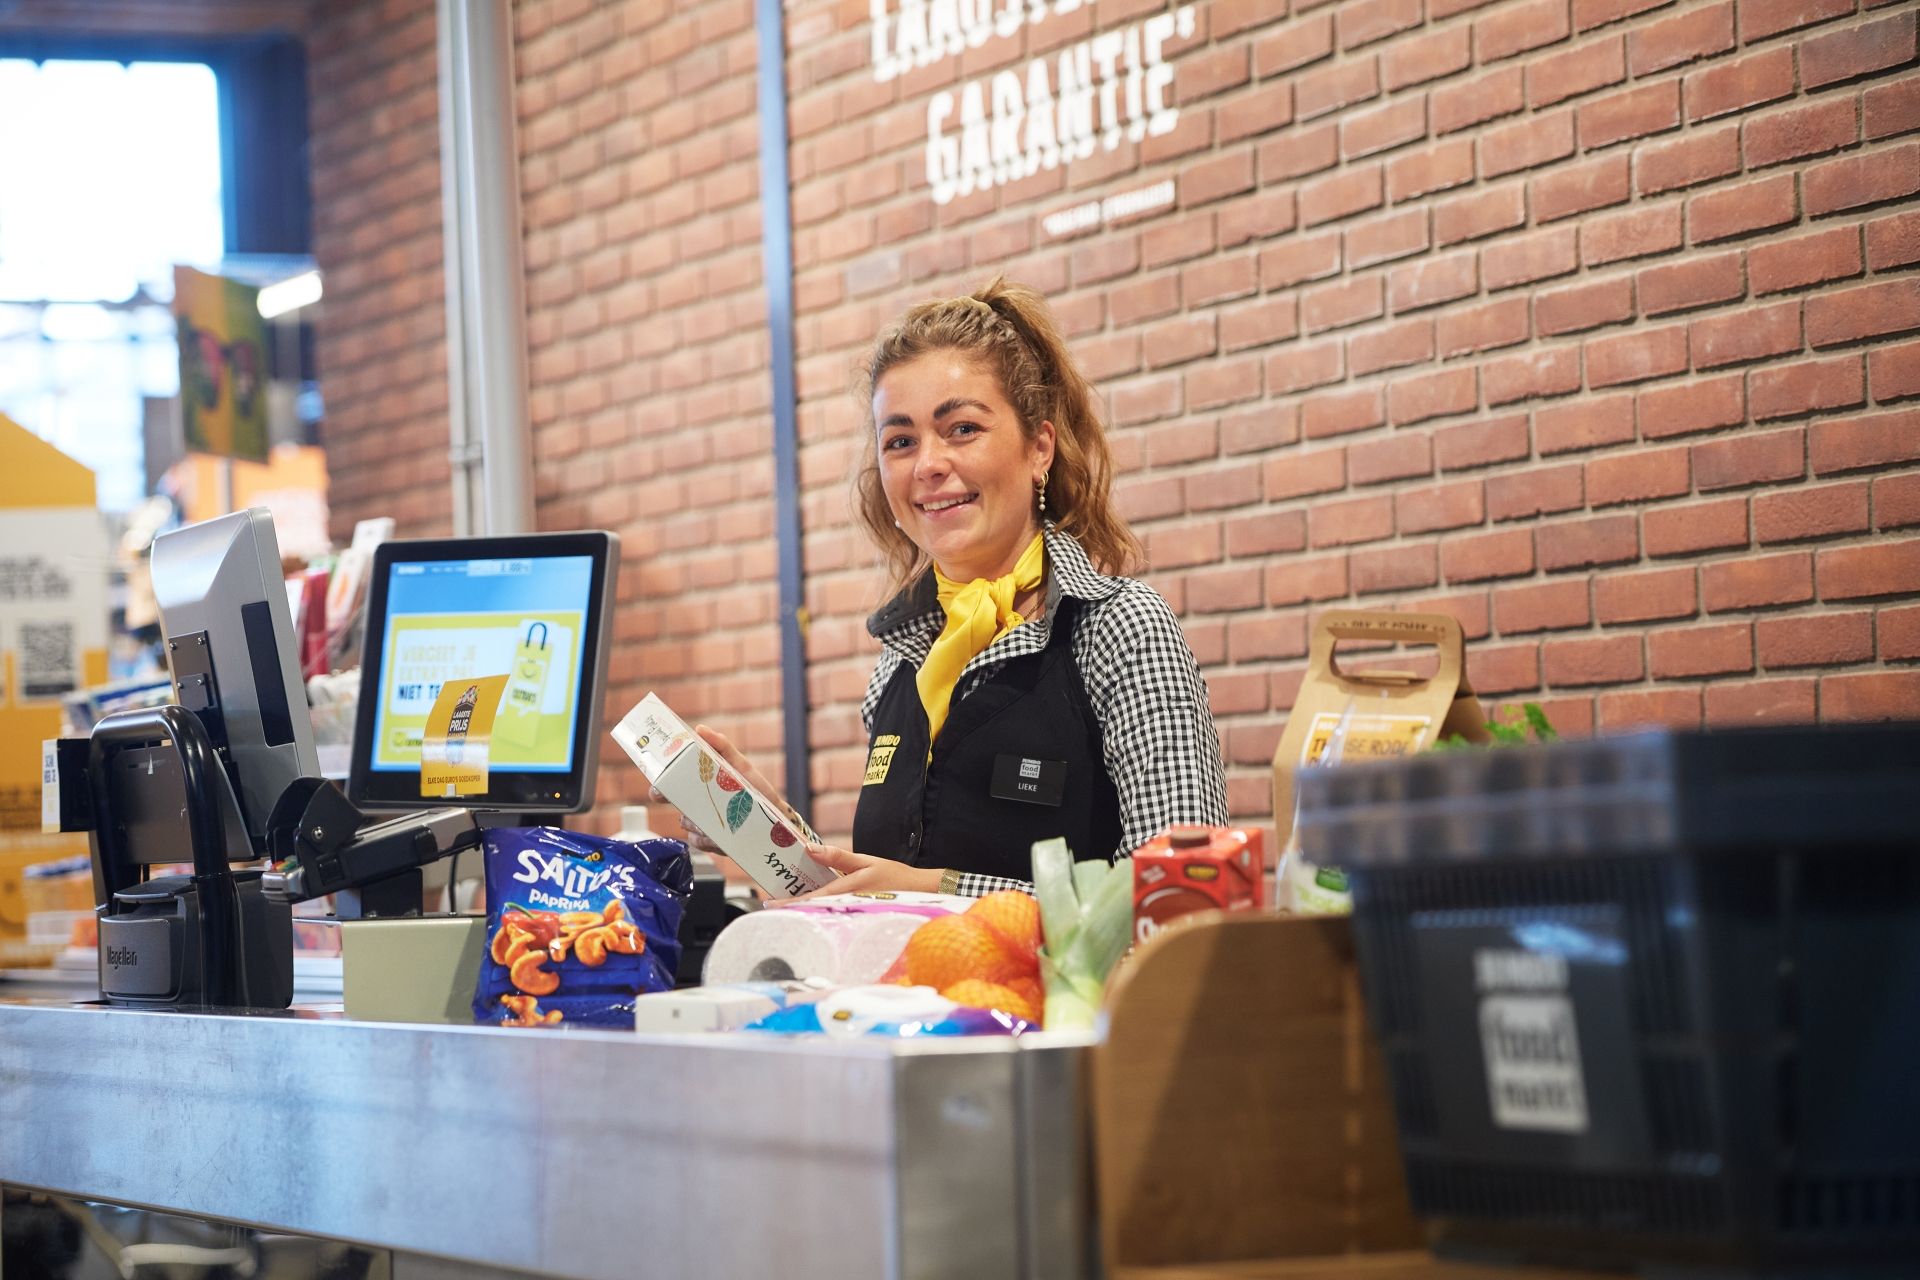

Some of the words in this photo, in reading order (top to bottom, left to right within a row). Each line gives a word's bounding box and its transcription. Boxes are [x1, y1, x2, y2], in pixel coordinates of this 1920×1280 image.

[397, 684, 422, 700] NIET
[452, 709, 472, 719] LAAGSTE
[449, 718, 469, 732] PRIJS
[873, 735, 900, 747] JUMBO
[869, 750, 892, 768] food
[1022, 764, 1040, 774] food
[1018, 782, 1039, 793] LIEKE
[512, 849, 636, 898] SALTO'S
[763, 851, 804, 897] Flakes
[106, 945, 138, 970] Magellan
